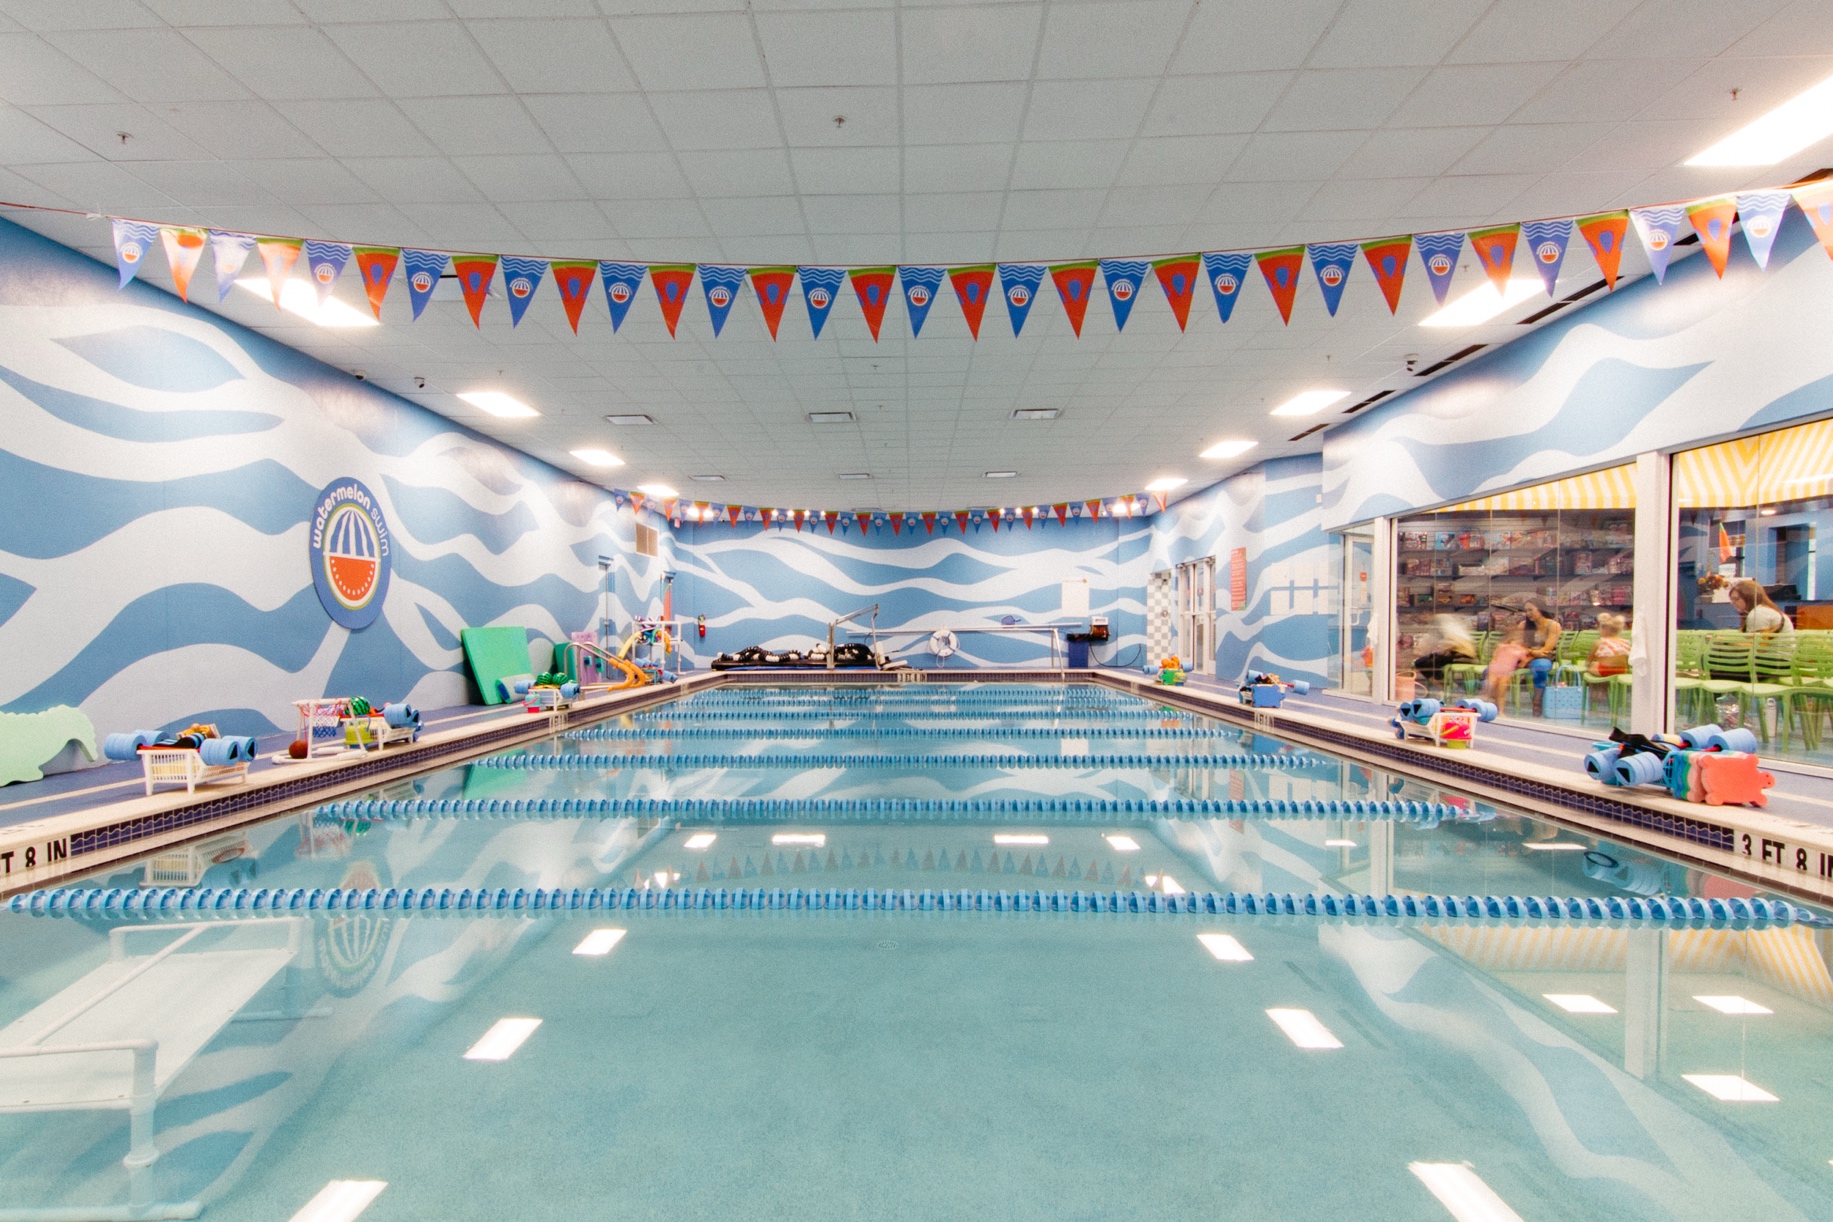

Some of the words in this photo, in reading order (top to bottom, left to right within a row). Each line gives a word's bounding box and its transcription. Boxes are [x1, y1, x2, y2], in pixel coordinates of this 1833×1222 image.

[313, 483, 371, 549] watermelon
[370, 508, 389, 556] swim
[0, 851, 14, 873] T
[25, 846, 36, 868] 8
[47, 838, 67, 862] IN
[1742, 834, 1752, 856] 3
[1762, 838, 1785, 865] FT
[1796, 848, 1807, 871] 8
